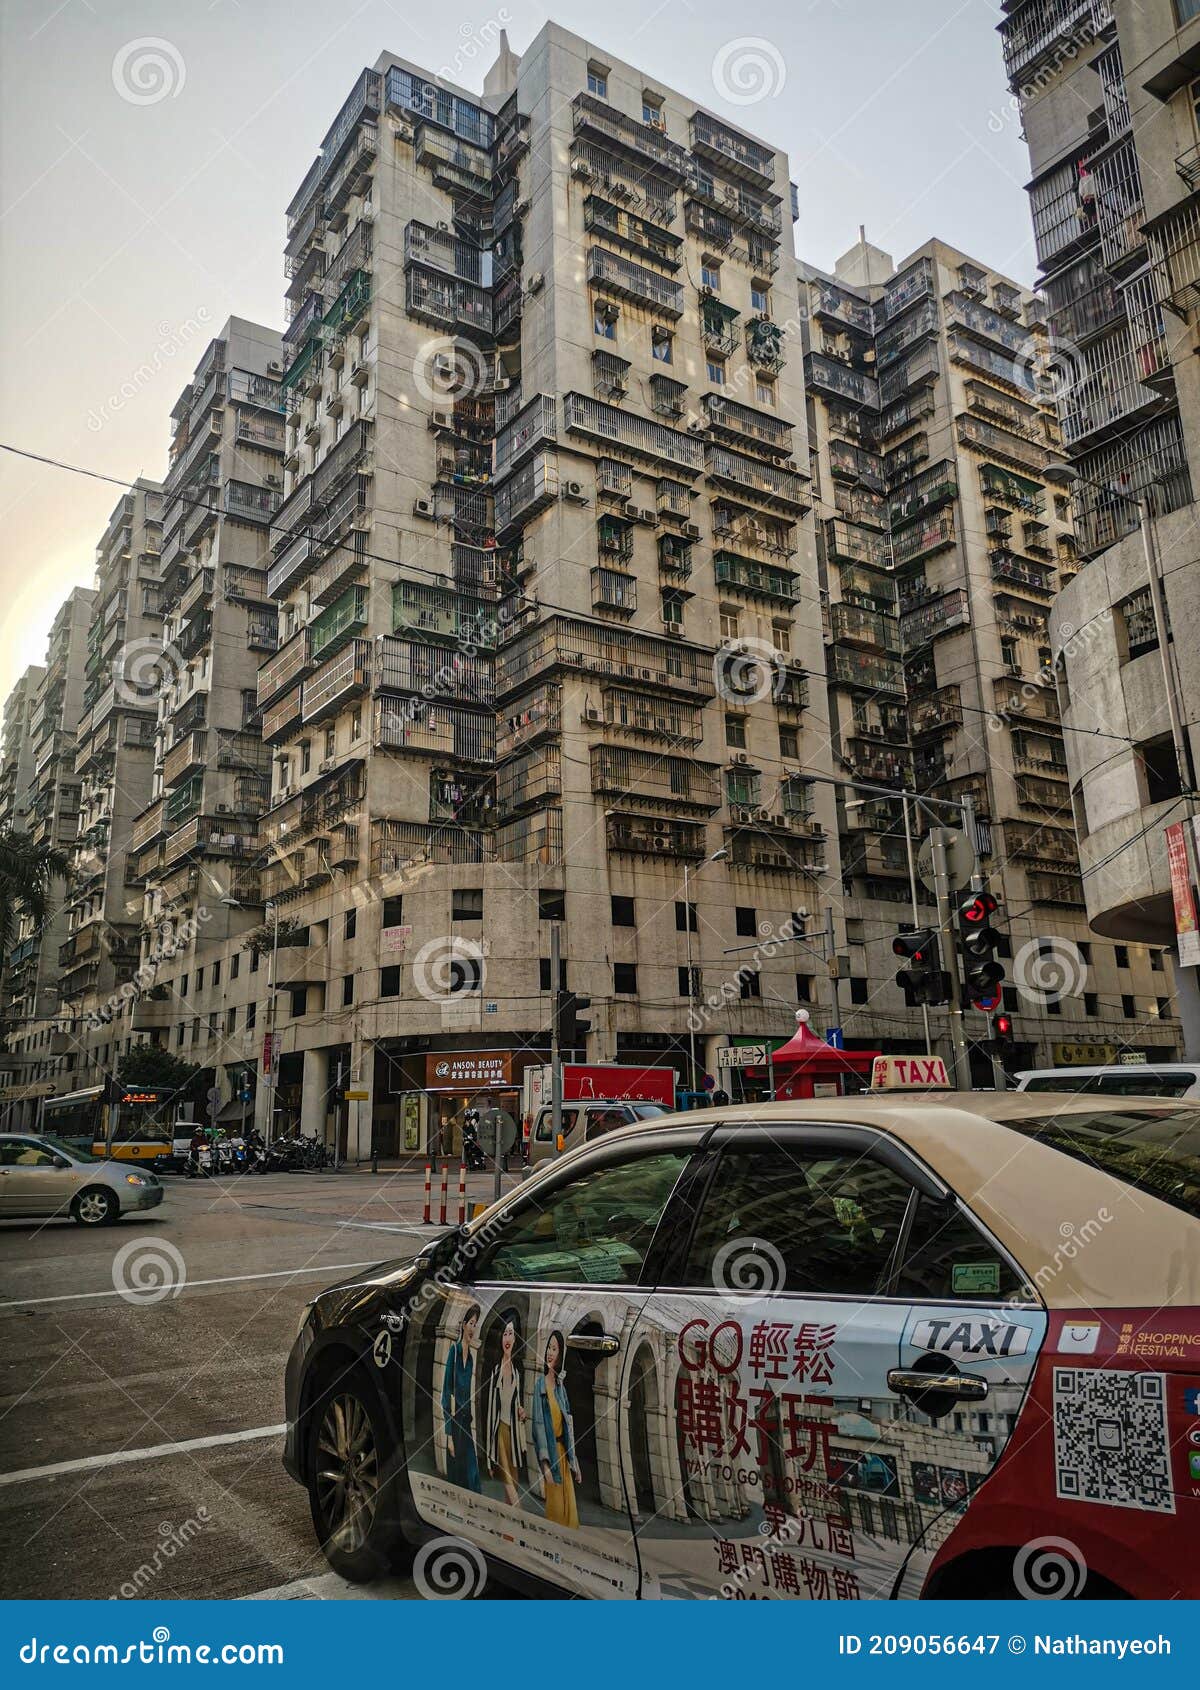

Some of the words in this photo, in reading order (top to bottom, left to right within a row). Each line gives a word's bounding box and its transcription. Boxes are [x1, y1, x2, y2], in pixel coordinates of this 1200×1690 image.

[452, 1061, 475, 1070] ANSON
[478, 1059, 503, 1069] BEAUTY
[721, 1057, 741, 1066] TAIPA
[894, 1060, 946, 1083] TAXI
[375, 1333, 389, 1364] 4
[926, 1321, 1017, 1356] TAXI
[1134, 1345, 1187, 1357] FESTIVAL
[677, 1377, 844, 1479] 購好玩
[684, 1458, 711, 1477] WAY
[715, 1464, 732, 1481] TO
[737, 1468, 759, 1486] GO
